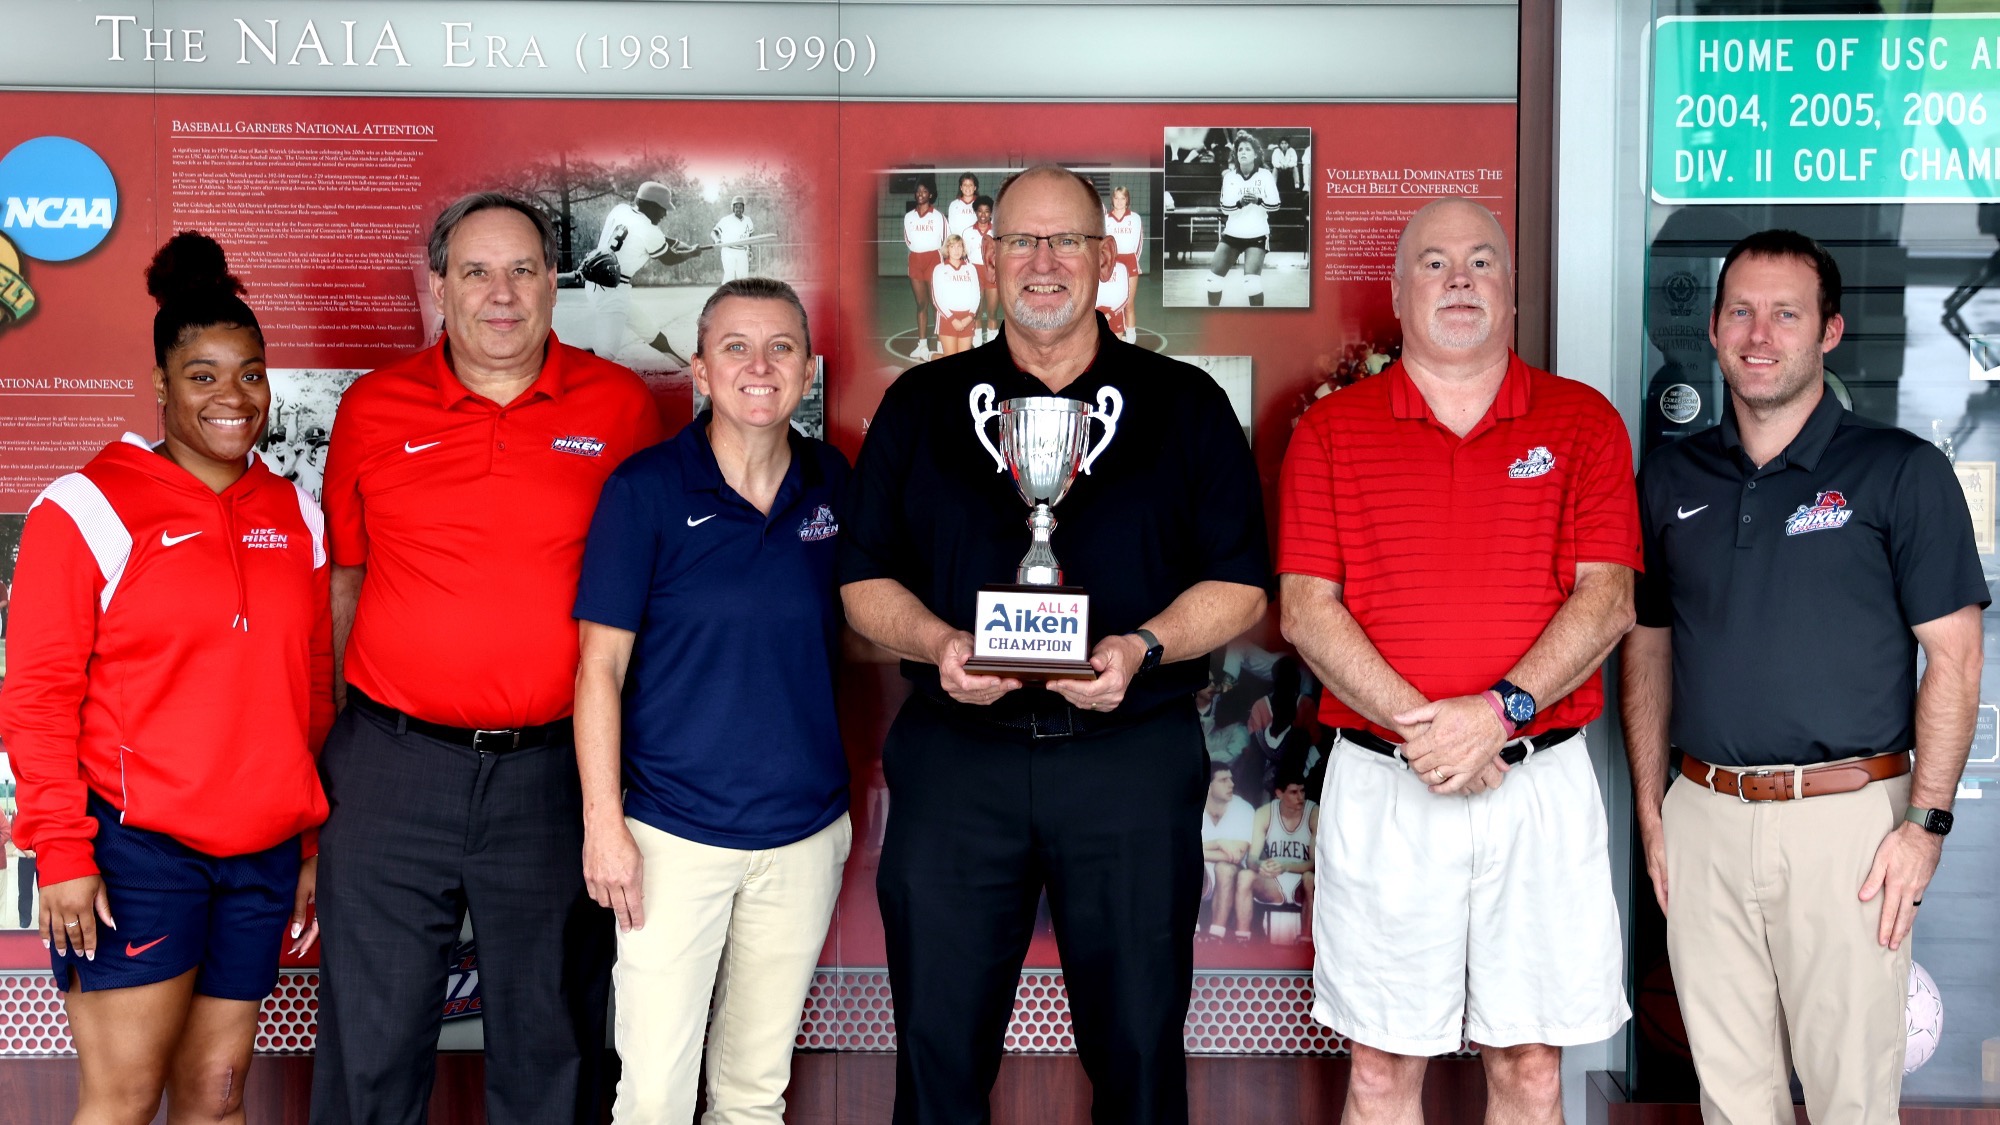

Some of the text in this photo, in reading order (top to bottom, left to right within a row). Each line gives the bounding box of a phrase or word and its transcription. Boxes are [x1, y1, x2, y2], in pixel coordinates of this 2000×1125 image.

[234, 18, 411, 68] NAIA
[575, 32, 694, 74] (1981
[756, 34, 878, 76] 1990)
[1699, 38, 1794, 72] HOME
[1816, 38, 1859, 72] OF
[1881, 36, 1948, 71] USC
[1675, 92, 1988, 132] 2004, 2005, 2006
[172, 120, 434, 136] BASEBALL GARNERS NATIONAL ATTENTION
[1326, 168, 1503, 180] VOLLEYBALL DOMINATES THE
[1675, 150, 1734, 183] DIV.
[1755, 149, 1772, 182] II
[1794, 148, 1877, 181] GOLF
[1326, 183, 1479, 194] PEACH BELT CONFERENCE
[4, 197, 113, 229] NCAA
[0, 268, 35, 310] ELT
[0, 378, 134, 390] ATIONAL PROMINENCE
[554, 439, 603, 451] AIKEN
[1792, 510, 1853, 530] AIKEN
[1037, 602, 1078, 614] ALL 4
[984, 604, 1078, 634] Aiken
[988, 638, 1072, 652] CHAMPION
[1269, 840, 1310, 861] AIKEN
